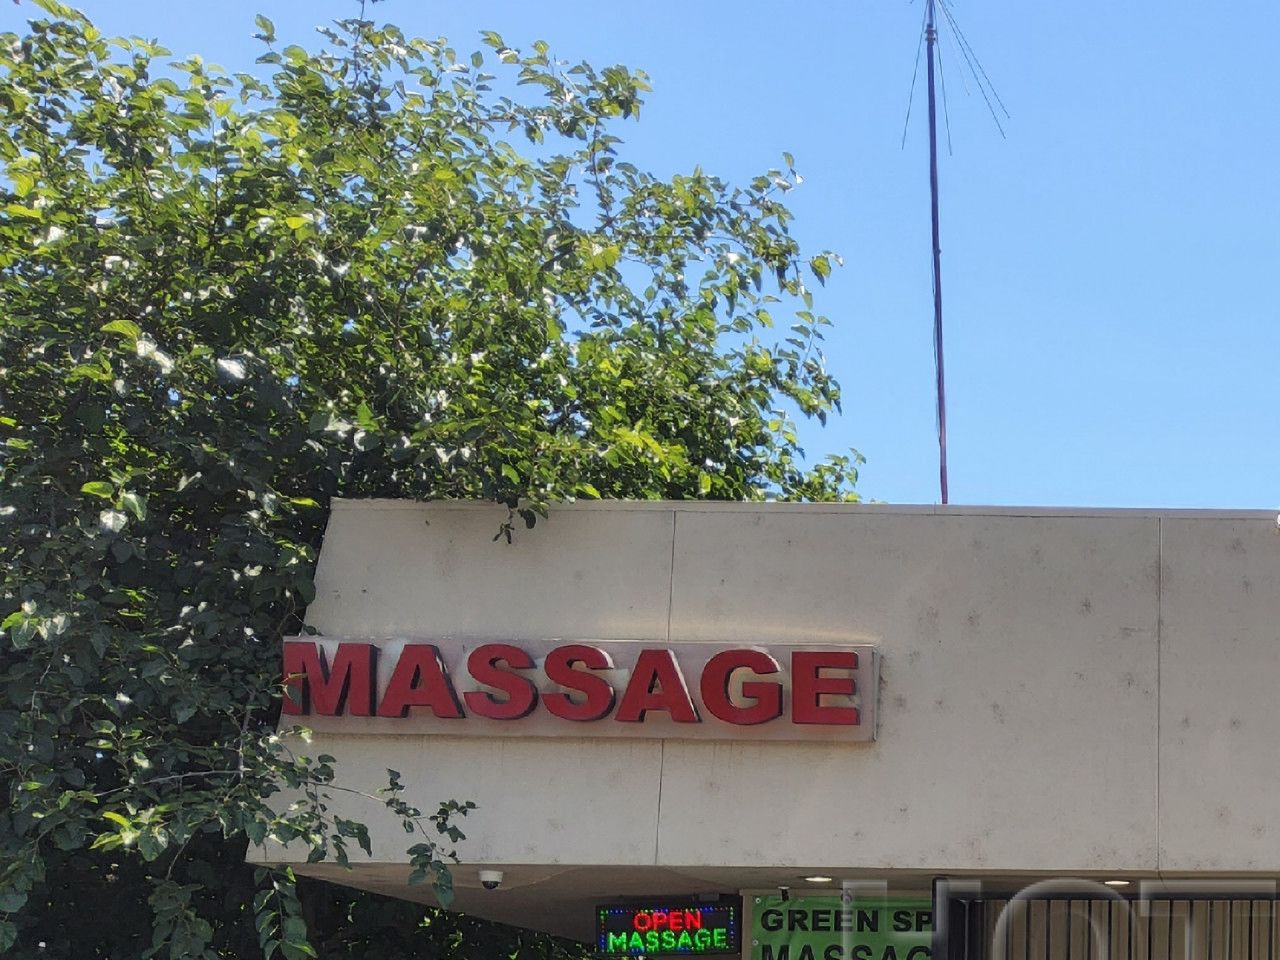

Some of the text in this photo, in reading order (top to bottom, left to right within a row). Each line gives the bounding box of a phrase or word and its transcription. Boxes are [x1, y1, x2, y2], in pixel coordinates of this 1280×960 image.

[283, 641, 861, 726] MASSAGE
[633, 910, 702, 931] OPEN
[761, 909, 879, 933] GREEN
[607, 928, 728, 953] MASSAGE
